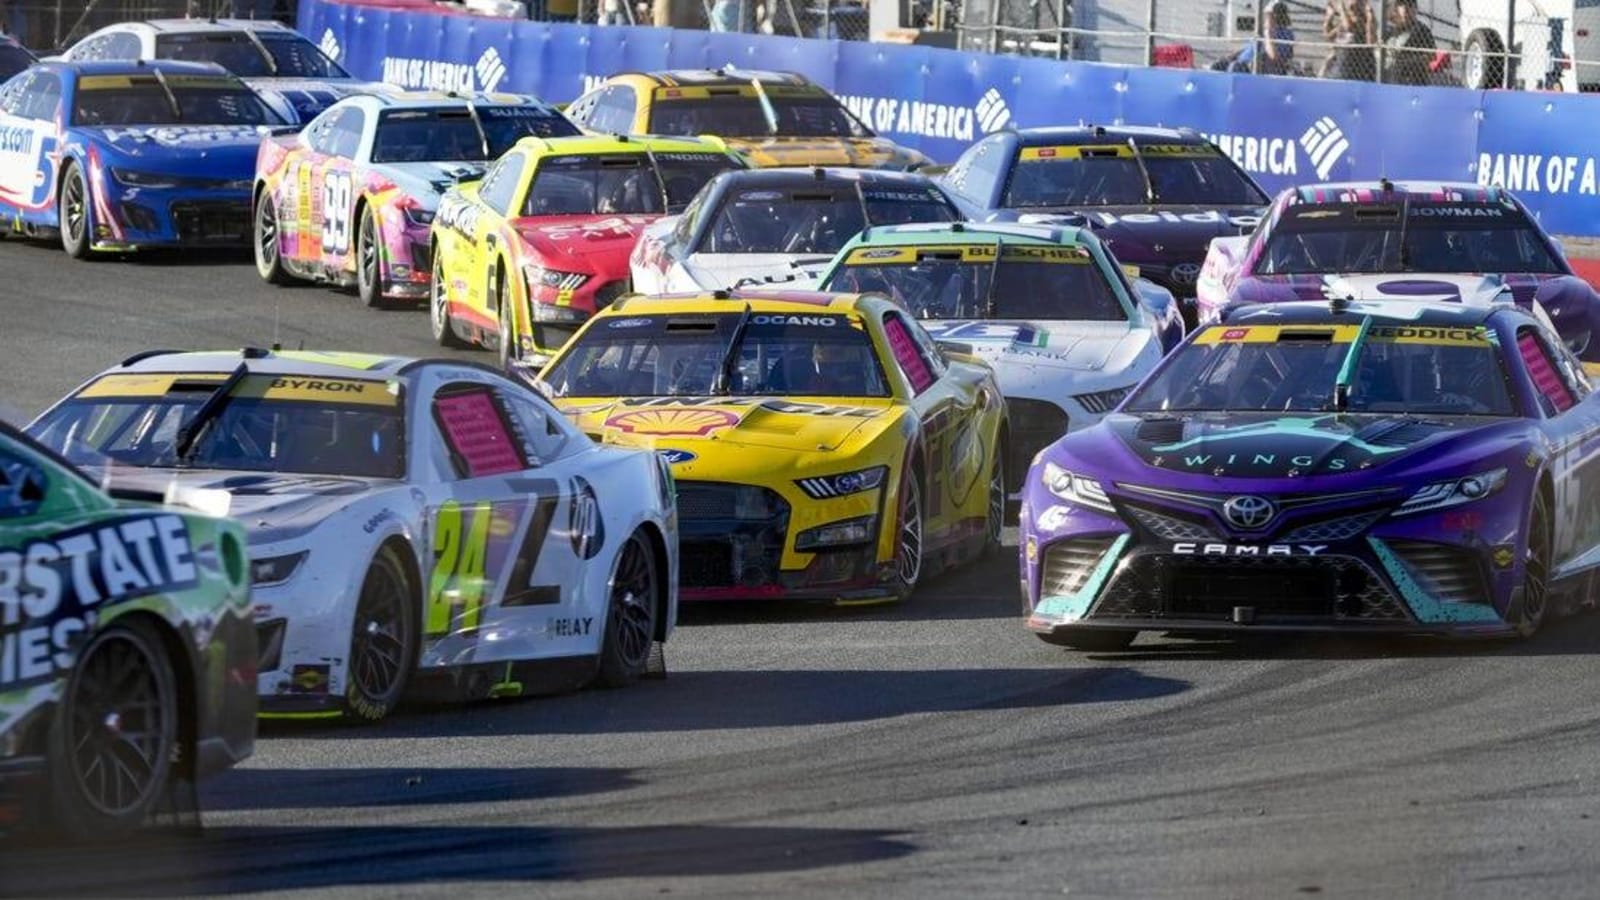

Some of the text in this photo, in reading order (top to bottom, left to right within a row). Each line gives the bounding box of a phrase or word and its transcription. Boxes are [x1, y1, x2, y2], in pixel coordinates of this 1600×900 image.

[409, 59, 423, 88] OF
[876, 98, 897, 132] OF
[897, 101, 974, 141] AMERICA
[32, 136, 57, 204] 5
[1477, 153, 1542, 191] BANK
[1546, 155, 1578, 194] OF
[270, 379, 364, 394] BYRON
[1184, 454, 1346, 470] WINGS
[423, 499, 492, 634] 24
[555, 617, 593, 636] RELAY
